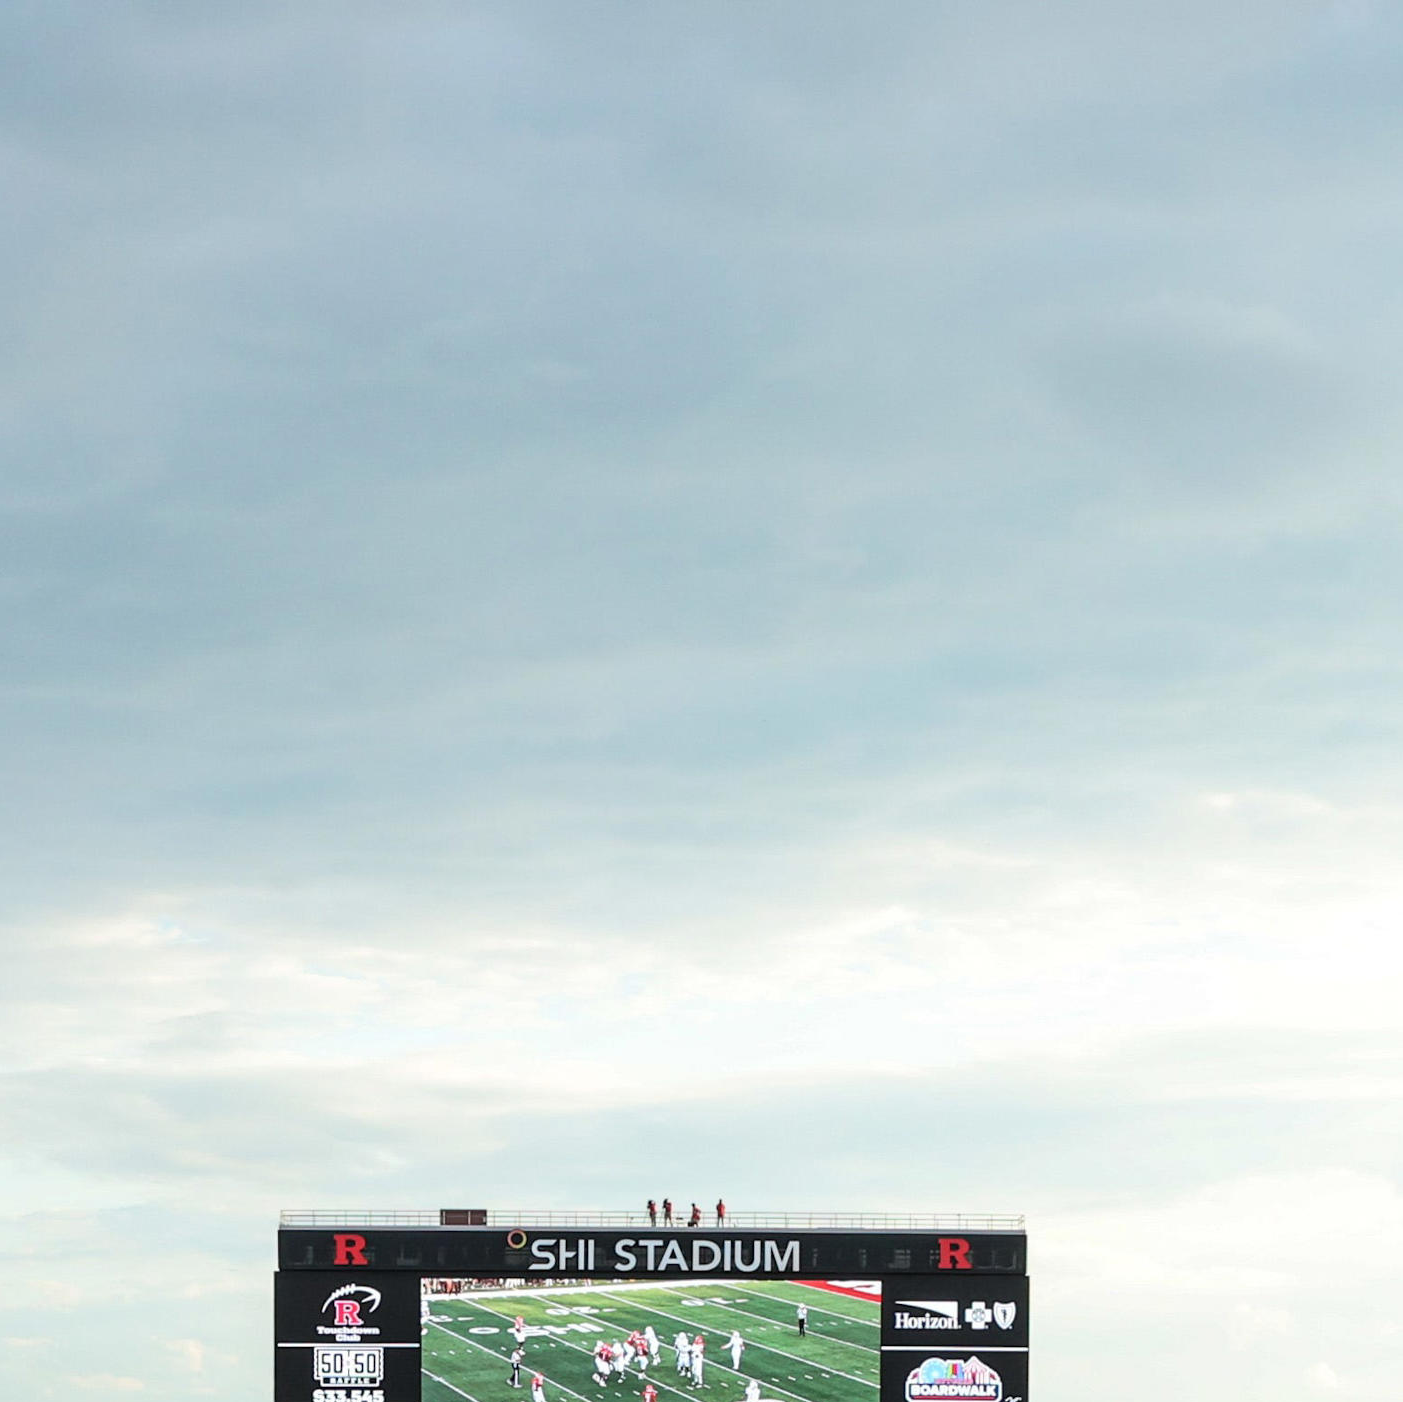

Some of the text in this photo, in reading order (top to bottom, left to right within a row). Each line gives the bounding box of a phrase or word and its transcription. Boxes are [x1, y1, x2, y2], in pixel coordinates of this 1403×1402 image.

[333, 1234, 369, 1265] R
[528, 1239, 800, 1272] SHI STADIUM
[938, 1238, 973, 1269] R
[334, 1300, 364, 1325] R
[910, 1384, 997, 1396] BOARDWALK
